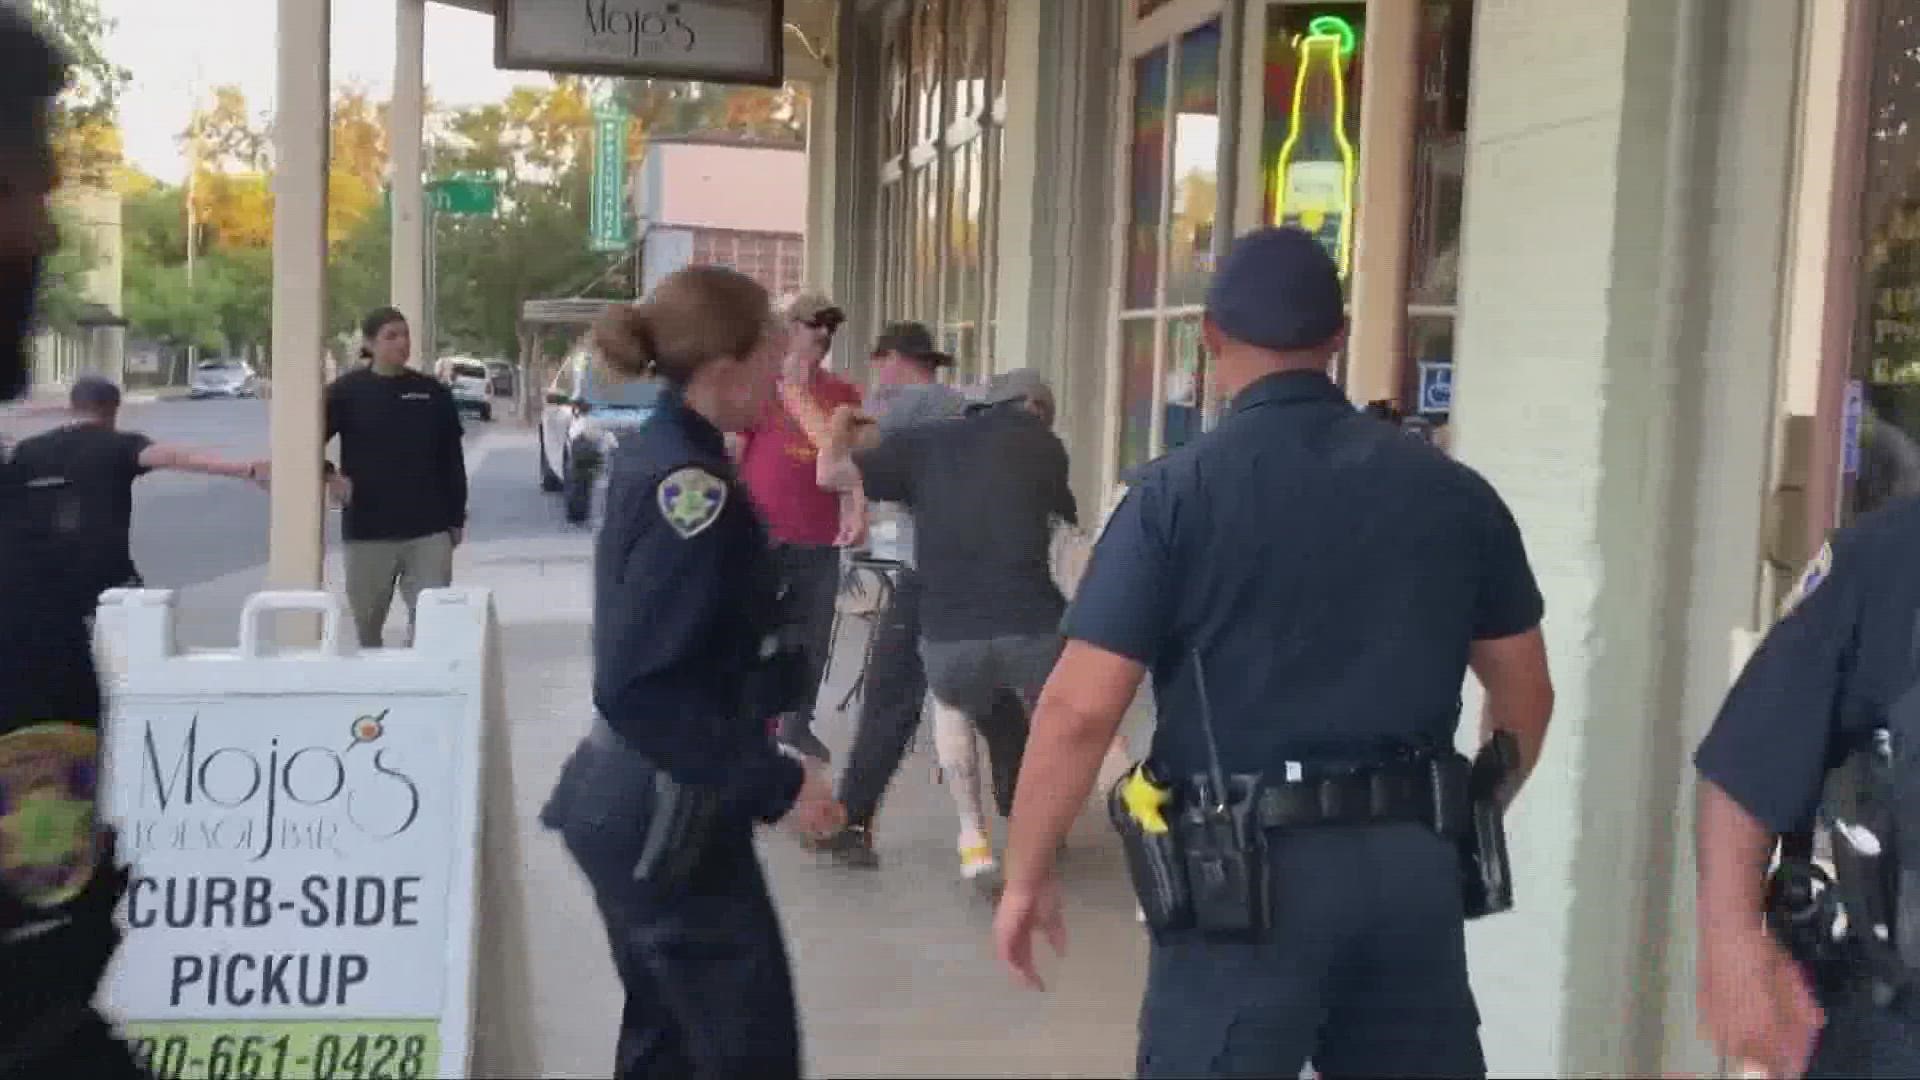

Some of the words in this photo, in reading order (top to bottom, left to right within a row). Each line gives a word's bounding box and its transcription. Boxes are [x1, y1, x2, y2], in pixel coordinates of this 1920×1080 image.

[582, 0, 695, 57] Mojo's
[139, 708, 419, 862] Mojo's
[127, 875, 421, 928] CURB-SIDE
[169, 953, 368, 1006] PICKUP
